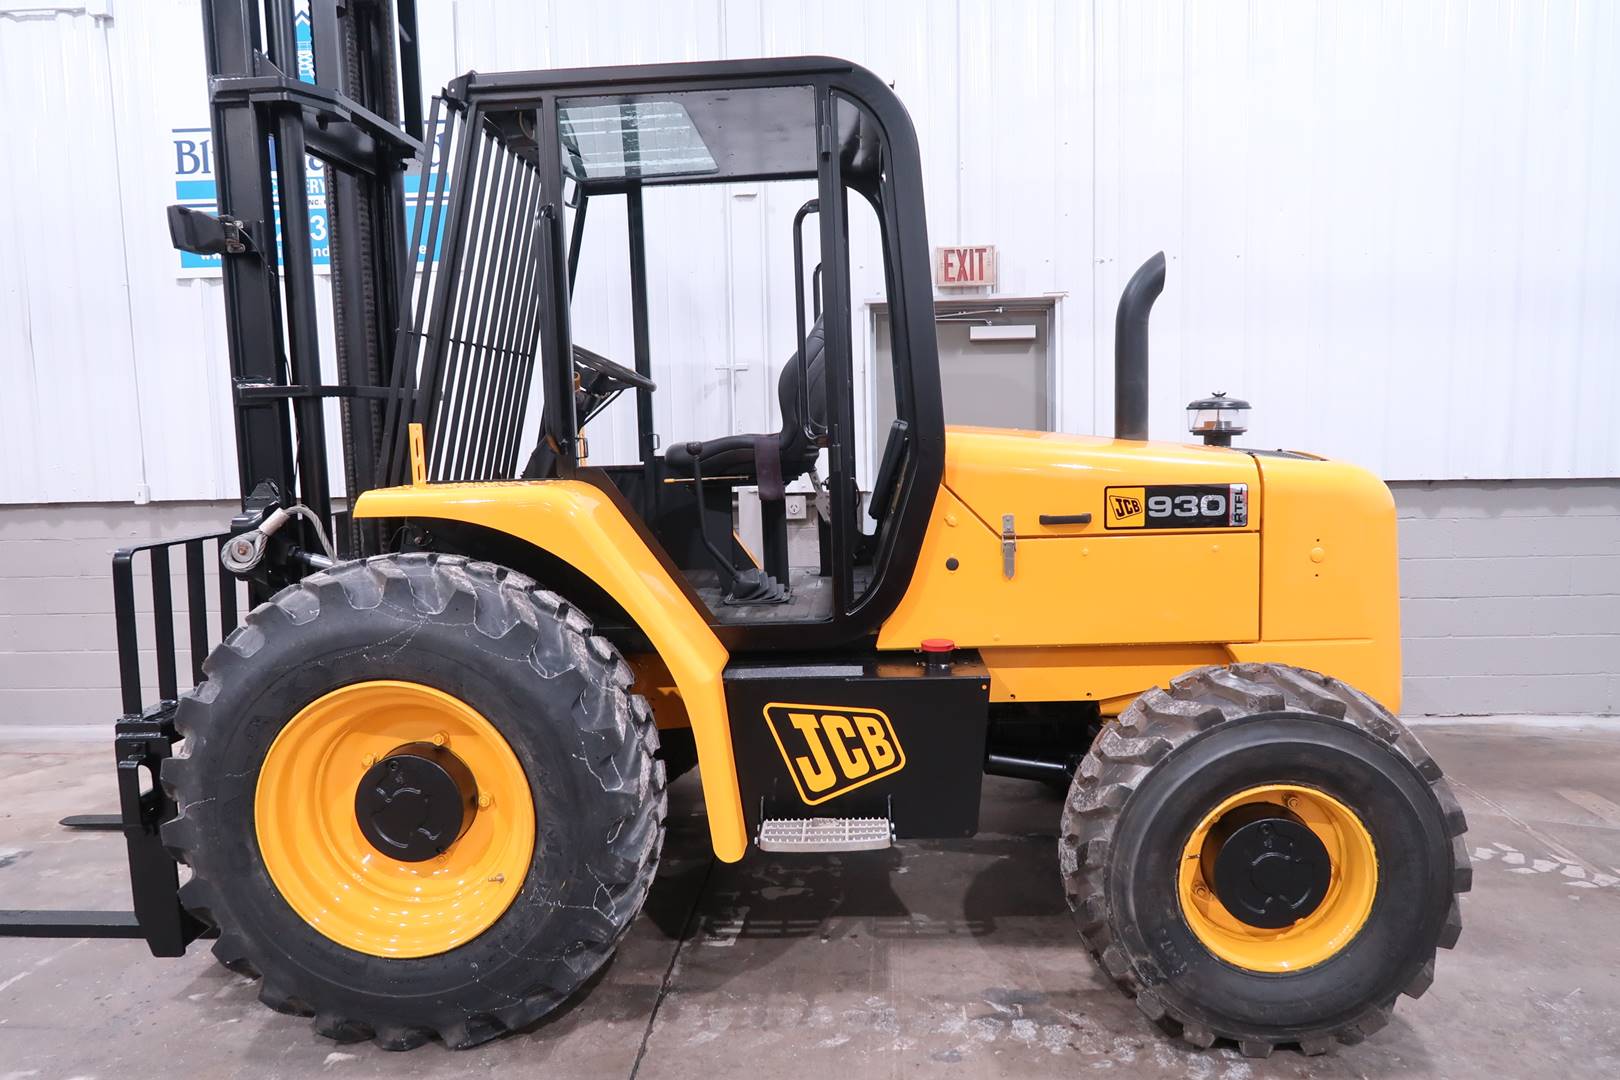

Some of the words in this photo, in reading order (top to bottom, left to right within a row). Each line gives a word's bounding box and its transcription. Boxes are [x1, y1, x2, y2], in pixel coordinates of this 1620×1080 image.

[943, 248, 987, 282] EXIT
[1115, 497, 1140, 518] JCB
[1148, 494, 1226, 518] 930
[1234, 487, 1244, 524] RTFL
[788, 713, 896, 793] JCB
